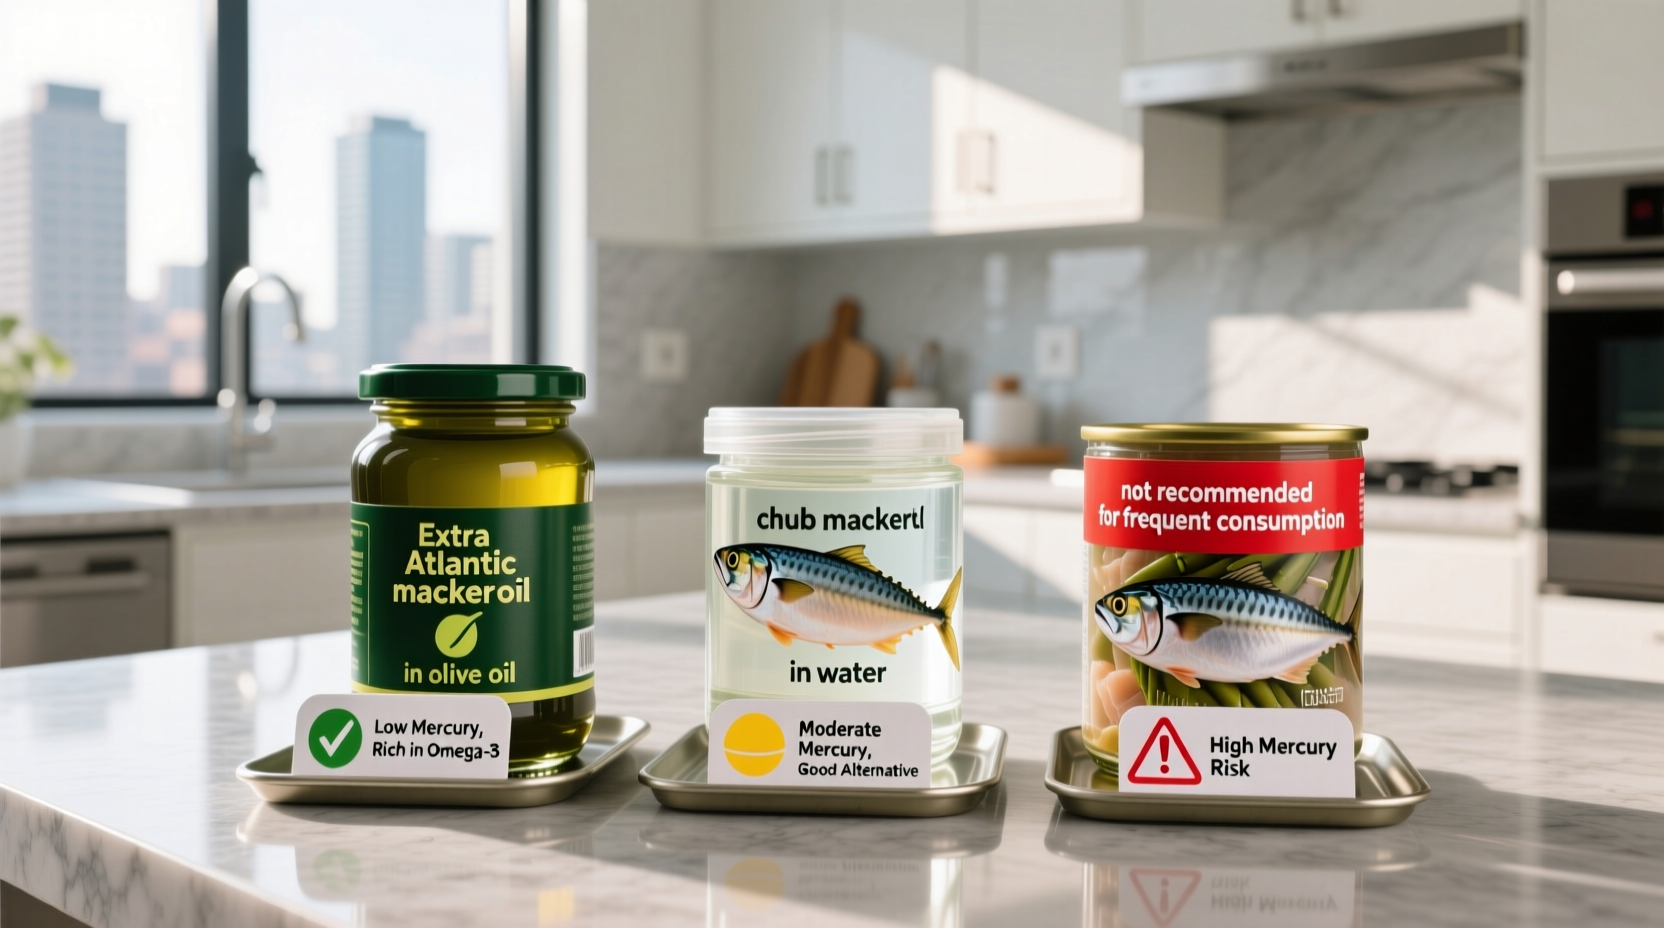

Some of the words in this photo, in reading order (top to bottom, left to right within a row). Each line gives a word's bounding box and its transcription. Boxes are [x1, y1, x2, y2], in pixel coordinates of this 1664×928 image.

[1121, 481, 1153, 502] not
[1157, 480, 1314, 504] recommended
[756, 505, 817, 531] chub
[1098, 503, 1121, 527] for
[1122, 505, 1211, 536] frequent
[1216, 506, 1345, 536] consumption
[418, 522, 490, 548] Extra
[404, 549, 517, 576] Atlantic
[404, 661, 423, 684] in
[428, 662, 482, 685] olive
[488, 660, 516, 684] oil
[790, 659, 811, 683] in
[816, 662, 887, 684] water
[374, 719, 408, 735] Low
[411, 719, 483, 740] Mercury,
[799, 719, 882, 738] Moderate
[372, 740, 406, 757] Rich
[410, 741, 424, 758] in
[427, 742, 500, 763] Omega-3
[798, 740, 872, 761] Mercury,
[1210, 736, 1254, 758] High
[1259, 736, 1337, 761] Mercury
[798, 762, 837, 776] Good
[840, 762, 919, 778] Alternative
[1210, 759, 1250, 777] Risk
